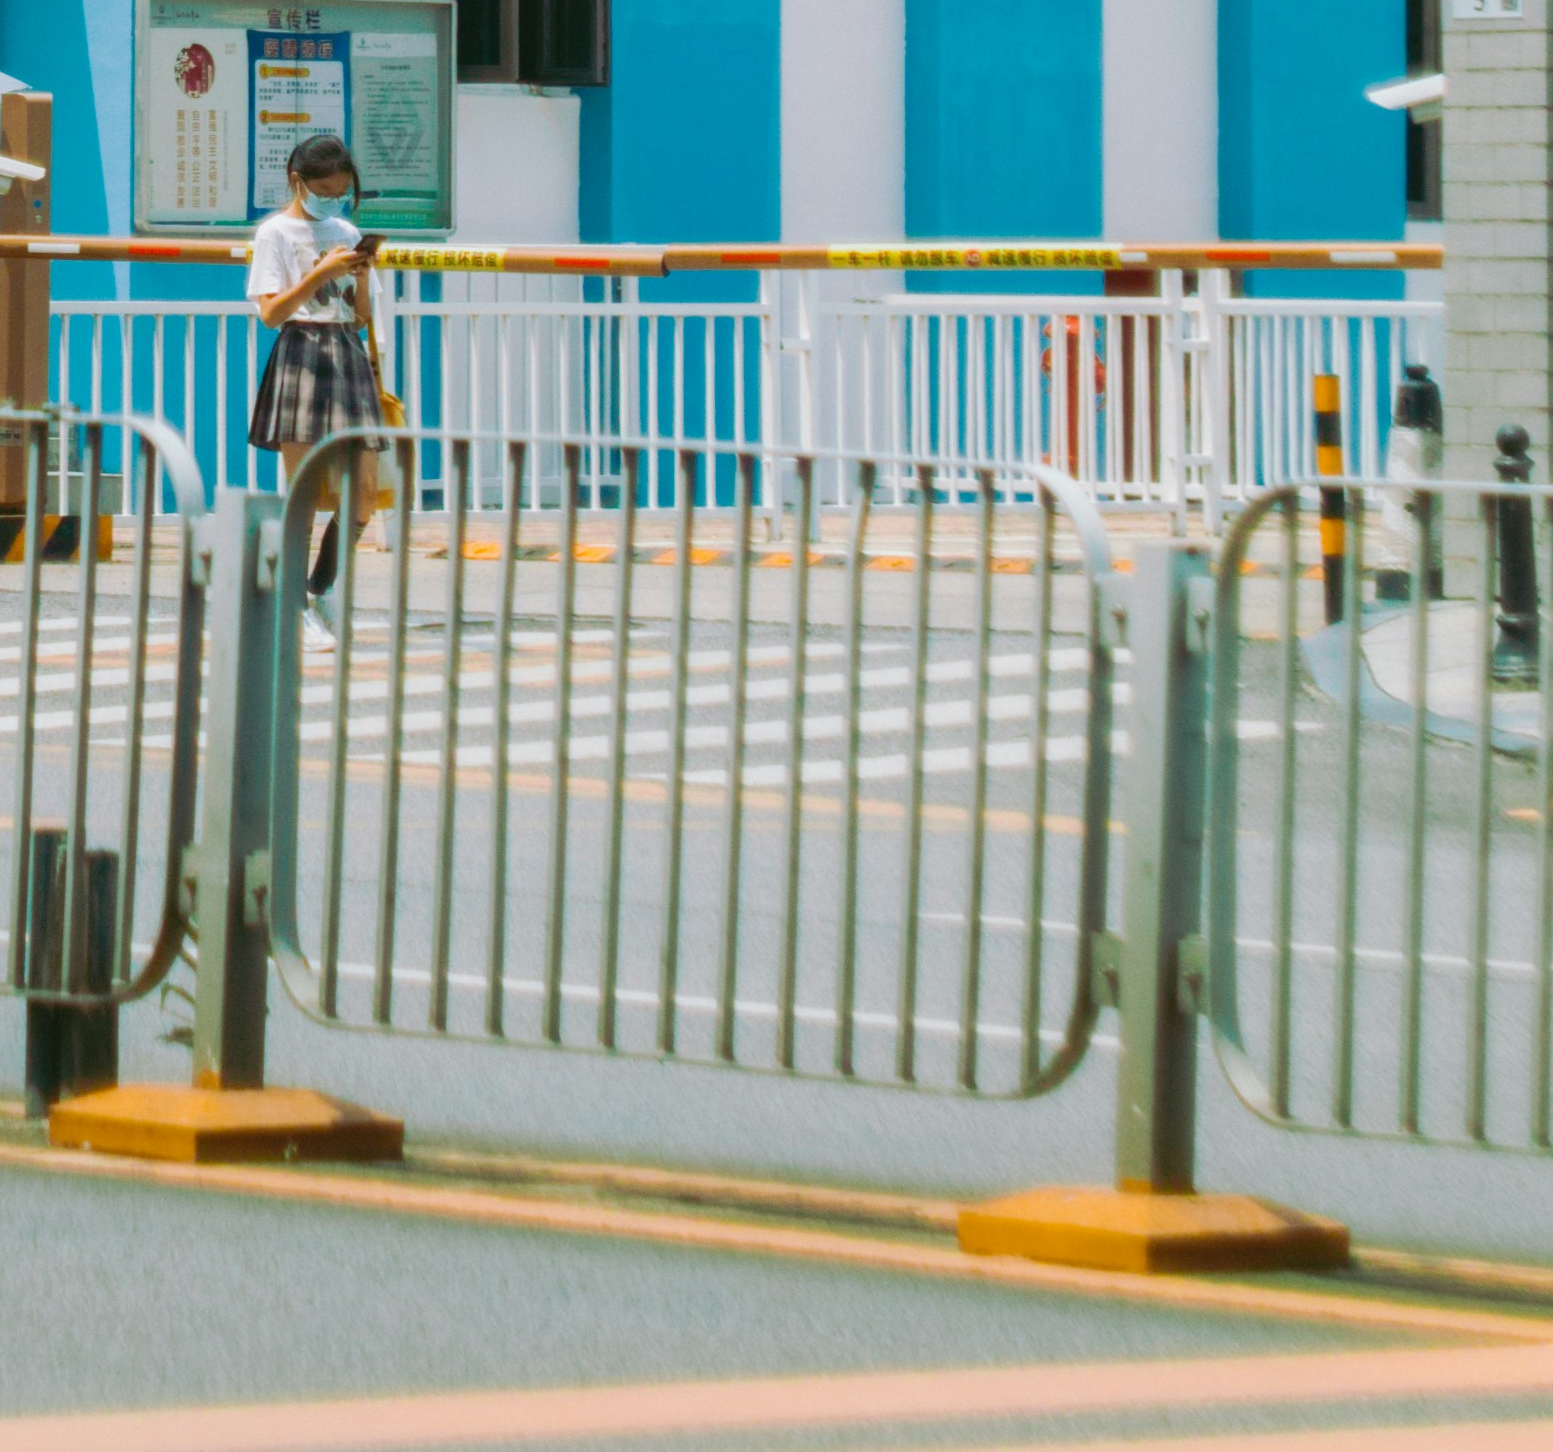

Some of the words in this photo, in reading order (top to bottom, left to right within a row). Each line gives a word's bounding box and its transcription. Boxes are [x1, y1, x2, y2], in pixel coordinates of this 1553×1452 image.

[267, 9, 322, 30] 宣传栏
[263, 38, 334, 60] 疫情防控
